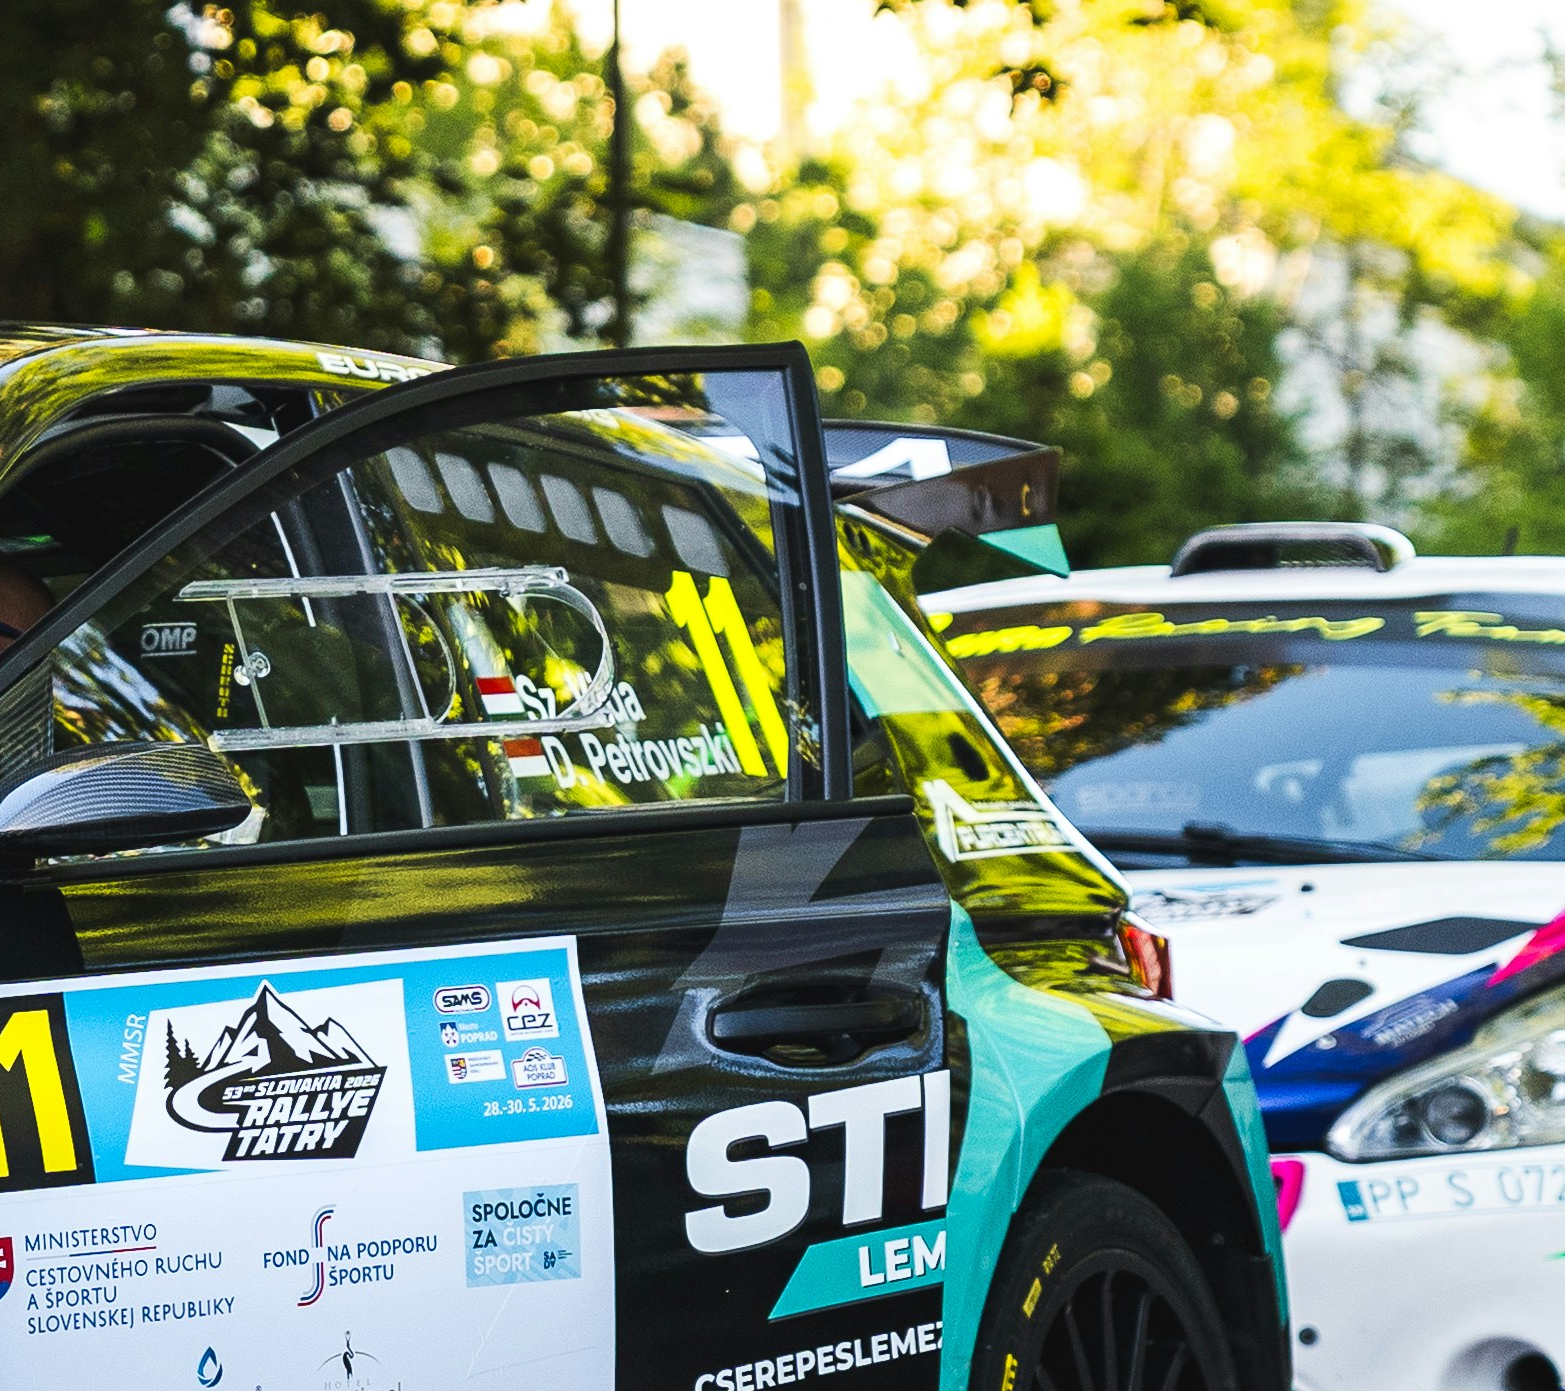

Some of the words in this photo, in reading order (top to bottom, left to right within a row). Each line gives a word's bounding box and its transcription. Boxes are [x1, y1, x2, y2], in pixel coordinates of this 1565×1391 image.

[140, 627, 197, 651] OMP
[665, 569, 788, 779] 11
[579, 721, 743, 785] Petrovszki
[441, 991, 483, 1008] SAMS
[118, 1013, 147, 1085] MMSR
[460, 1030, 499, 1045] POPRAD
[254, 1074, 343, 1097] SLOVAKIA
[344, 1073, 382, 1089] 2026
[527, 1071, 556, 1081] POPRAD
[242, 1088, 376, 1129] RALLYE
[541, 1094, 573, 1111] 2026
[235, 1119, 351, 1158] TATRY
[1367, 1176, 1420, 1212] PP
[1447, 1170, 1475, 1208] S
[471, 1192, 572, 1223] SPOLOČNE
[24, 1223, 158, 1253] MINISTERSTVO
[327, 1244, 351, 1262] NA
[356, 1234, 438, 1259] PODPORU
[472, 1229, 498, 1250] ZA
[502, 1219, 555, 1247] ČISTÝ
[25, 1257, 149, 1288] CESTOVNÉHO
[155, 1251, 223, 1276] RUCHU
[262, 1248, 310, 1269] FOND
[473, 1250, 533, 1276] ŠPORT
[328, 1263, 395, 1287] ŠPORTU
[26, 1293, 39, 1311] A
[45, 1285, 118, 1310] ŠPORTU
[27, 1307, 135, 1335] SLOVENSKEJ
[141, 1296, 236, 1324] REPUBLIKY
[324, 1376, 372, 1391] HOTEL
